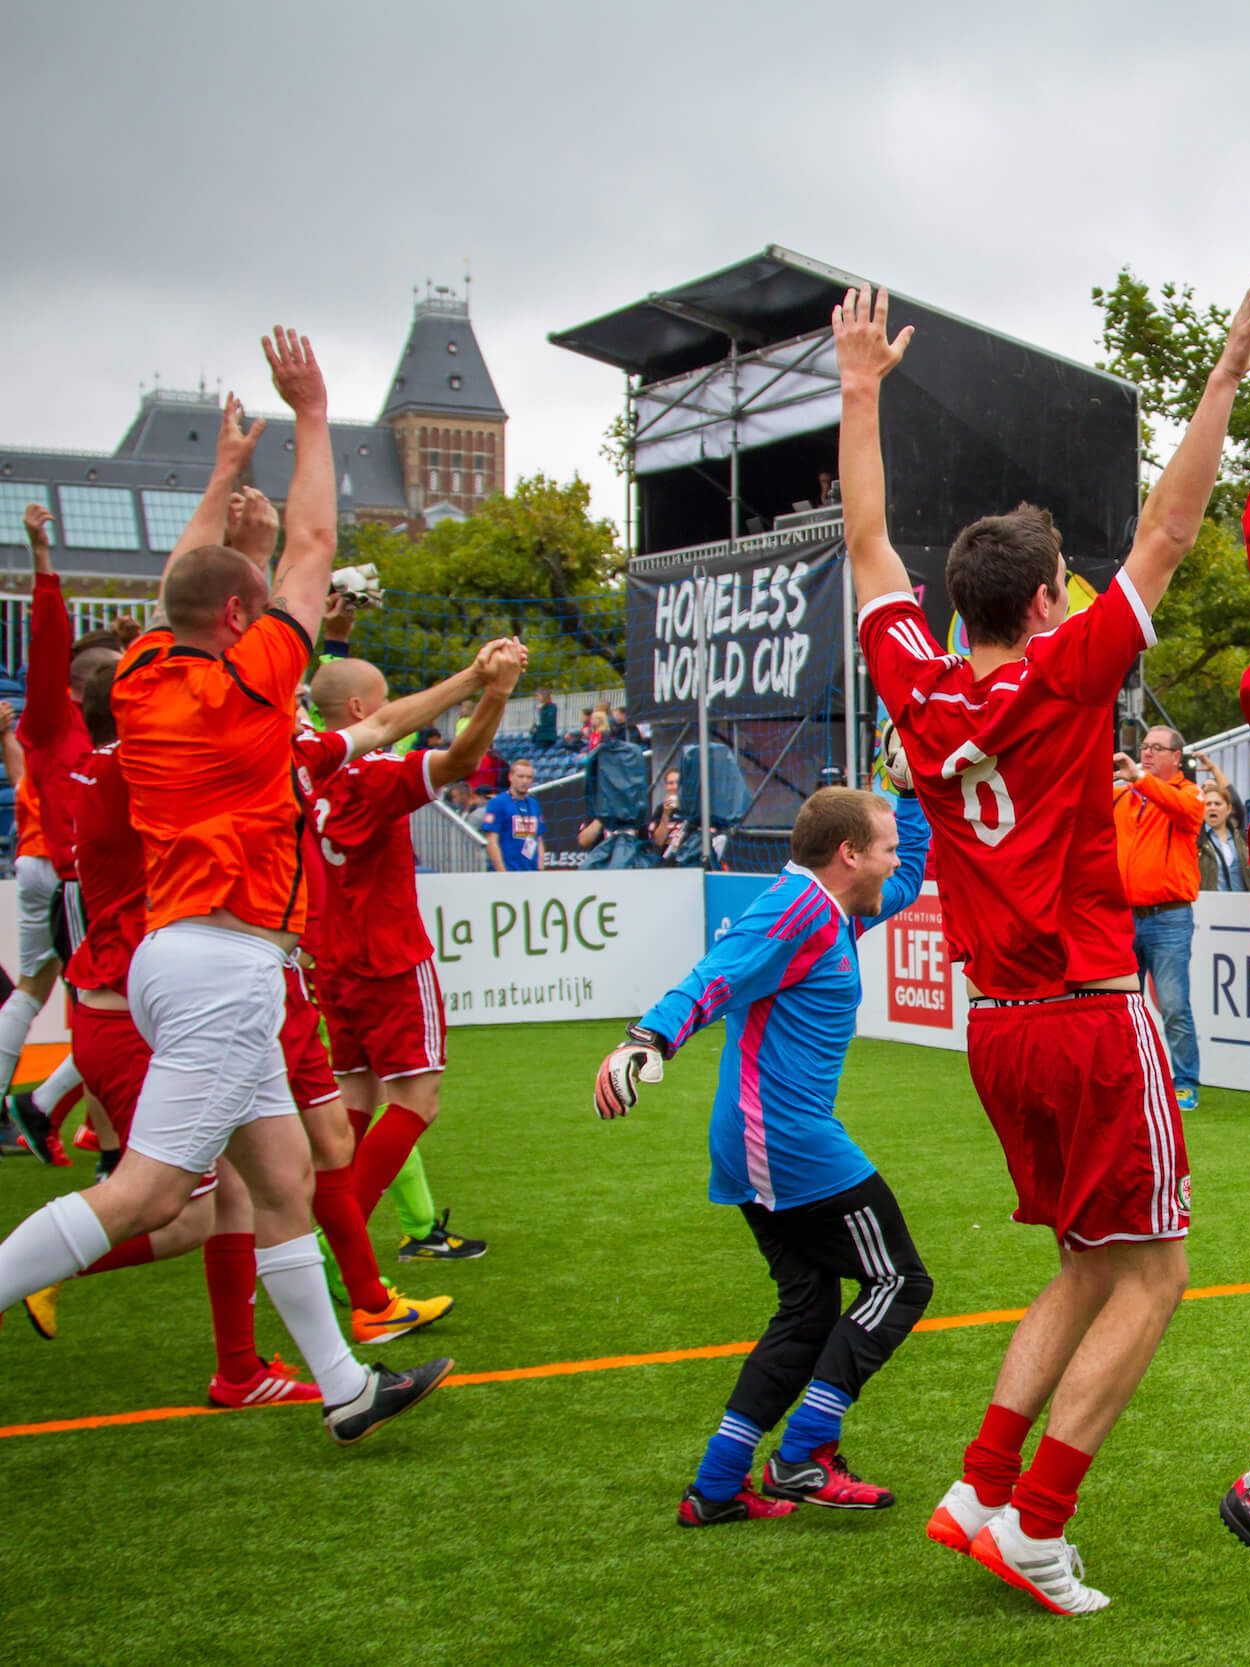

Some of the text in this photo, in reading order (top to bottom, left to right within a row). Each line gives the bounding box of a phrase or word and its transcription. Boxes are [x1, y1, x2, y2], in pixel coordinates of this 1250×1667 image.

[655, 562, 809, 642] HOMELESS
[654, 631, 810, 707] WORLD CUP
[435, 895, 618, 963] La PLACE
[484, 977, 593, 1008] natuurlijk
[895, 985, 945, 1011] GOALS!
